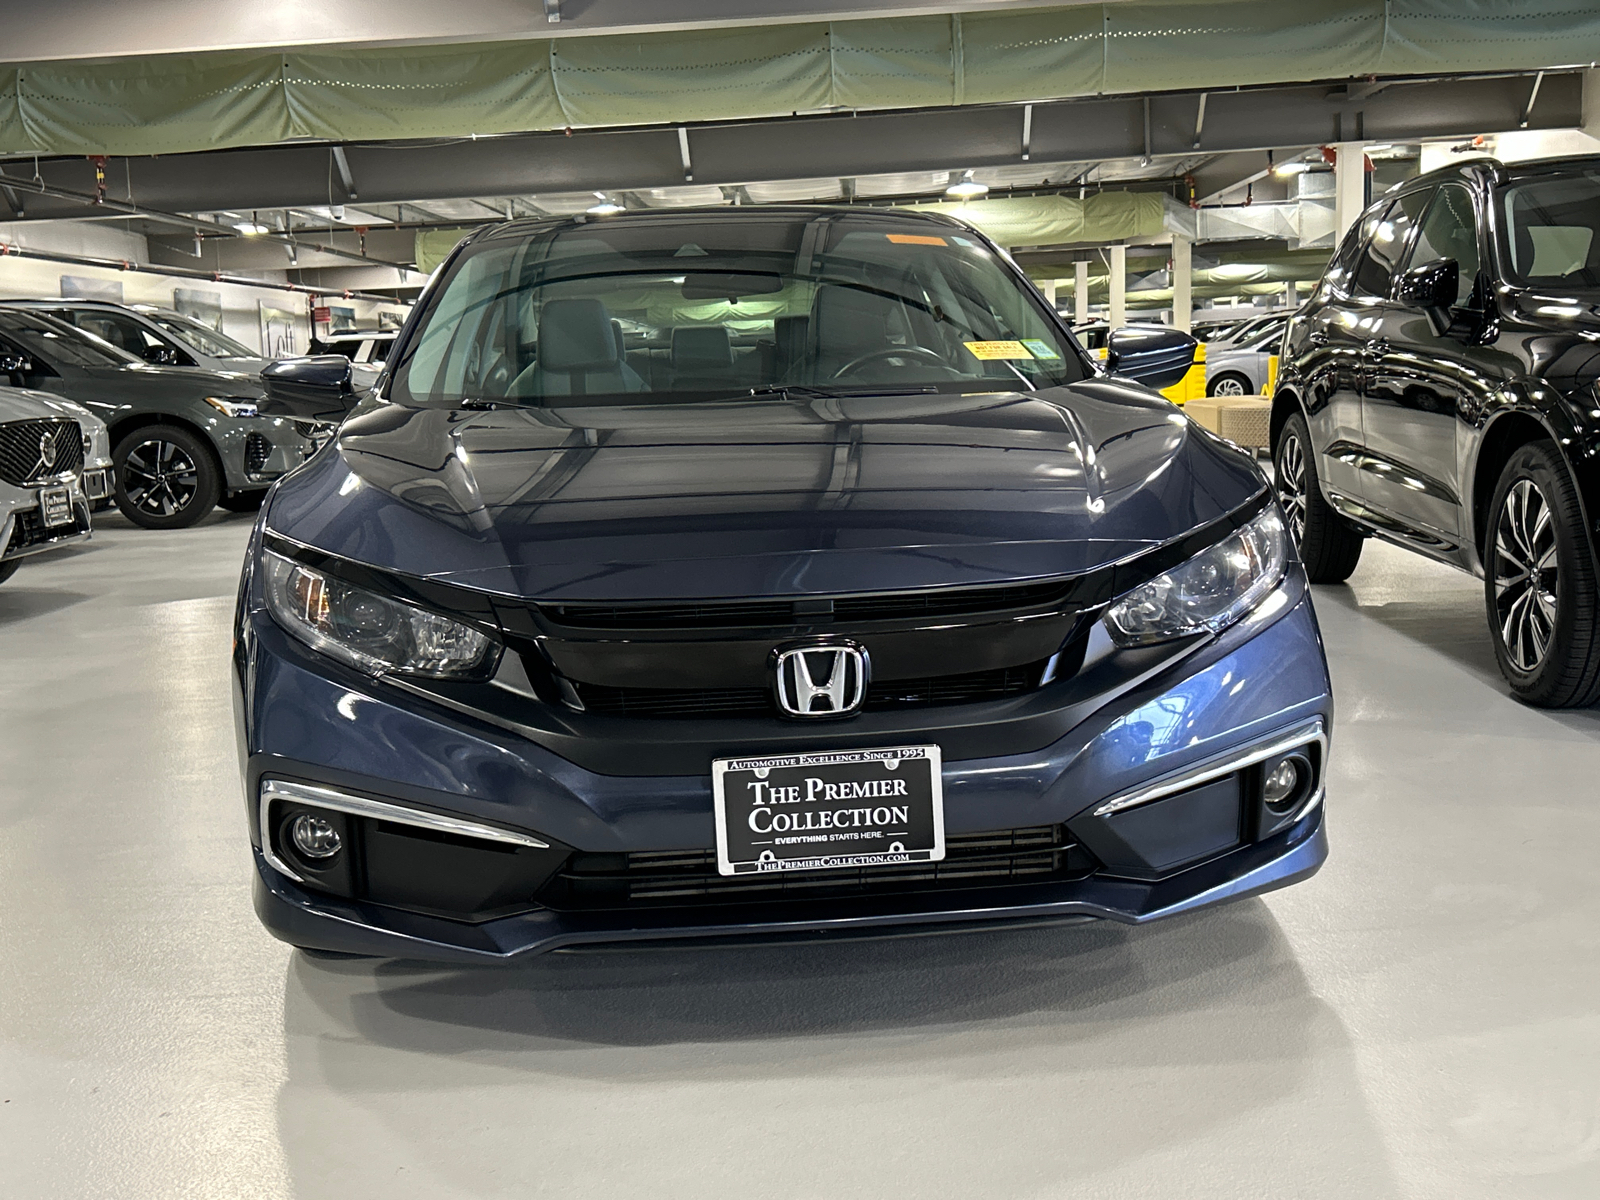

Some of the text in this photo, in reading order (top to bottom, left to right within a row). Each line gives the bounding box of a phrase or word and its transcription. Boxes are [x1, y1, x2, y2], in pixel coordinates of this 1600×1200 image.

[730, 748, 925, 770] AUTOMOTIVE EXCELLENCE SINCE 1995
[747, 778, 908, 806] THE PREMIER
[748, 805, 909, 833] COLLECTION
[774, 831, 885, 845] EVERYTHING STARTS HERE.
